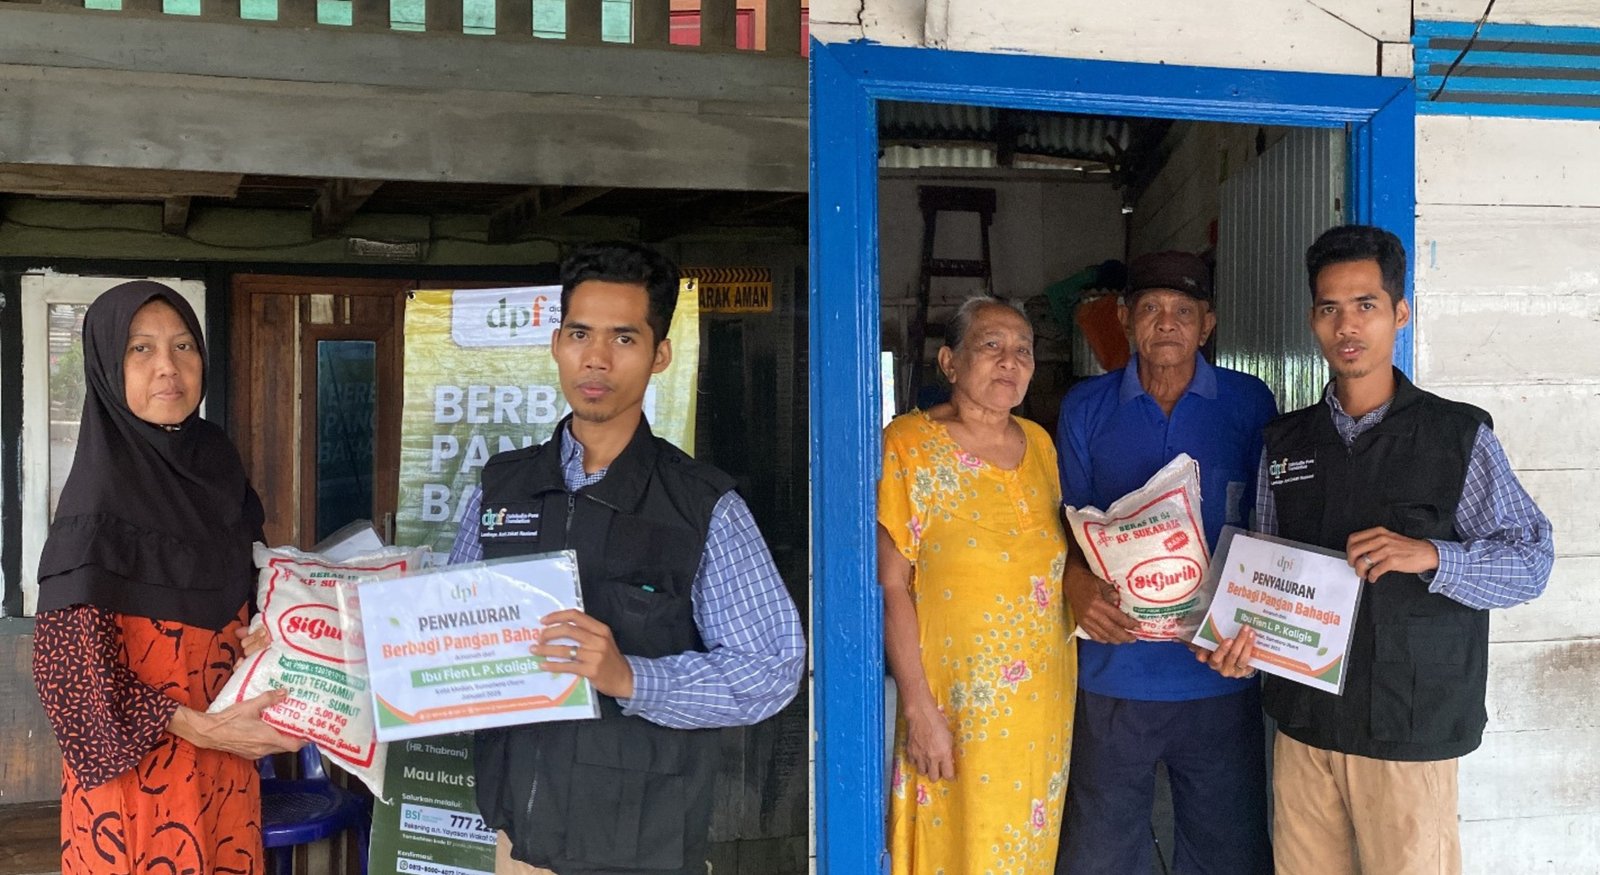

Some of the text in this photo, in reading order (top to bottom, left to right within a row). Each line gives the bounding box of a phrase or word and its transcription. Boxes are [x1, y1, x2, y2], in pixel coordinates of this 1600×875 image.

[699, 286, 768, 308] ARAK AMAN
[486, 296, 547, 337] dpf
[482, 507, 507, 530] dpf
[1252, 571, 1316, 600] PENYALURAN
[1226, 581, 1341, 626] Berbagi Pangan Bahagia
[418, 605, 521, 632] PENYALURAN
[382, 638, 440, 659] Berbagi
[444, 631, 500, 654] Pangan
[1283, 625, 1313, 644] Kaligis
[421, 669, 441, 683] Ibu
[483, 664, 495, 676] P.
[496, 660, 540, 676] Kaligis
[281, 671, 308, 687] MUTU
[310, 677, 355, 701] TERJAMIN
[281, 697, 307, 711] UTTO
[315, 707, 333, 719] 5.00
[335, 715, 347, 727] Kg
[328, 699, 361, 718] SUMUT
[328, 724, 341, 735] Kg
[406, 740, 468, 760] (HR. Thabrani)
[403, 766, 476, 788] Mau Ikut S
[401, 792, 433, 804] Salurkan
[405, 809, 420, 821] BSI
[450, 814, 472, 830] 777
[442, 828, 468, 838] Yayasan
[397, 849, 433, 860] Konfirmasi:
